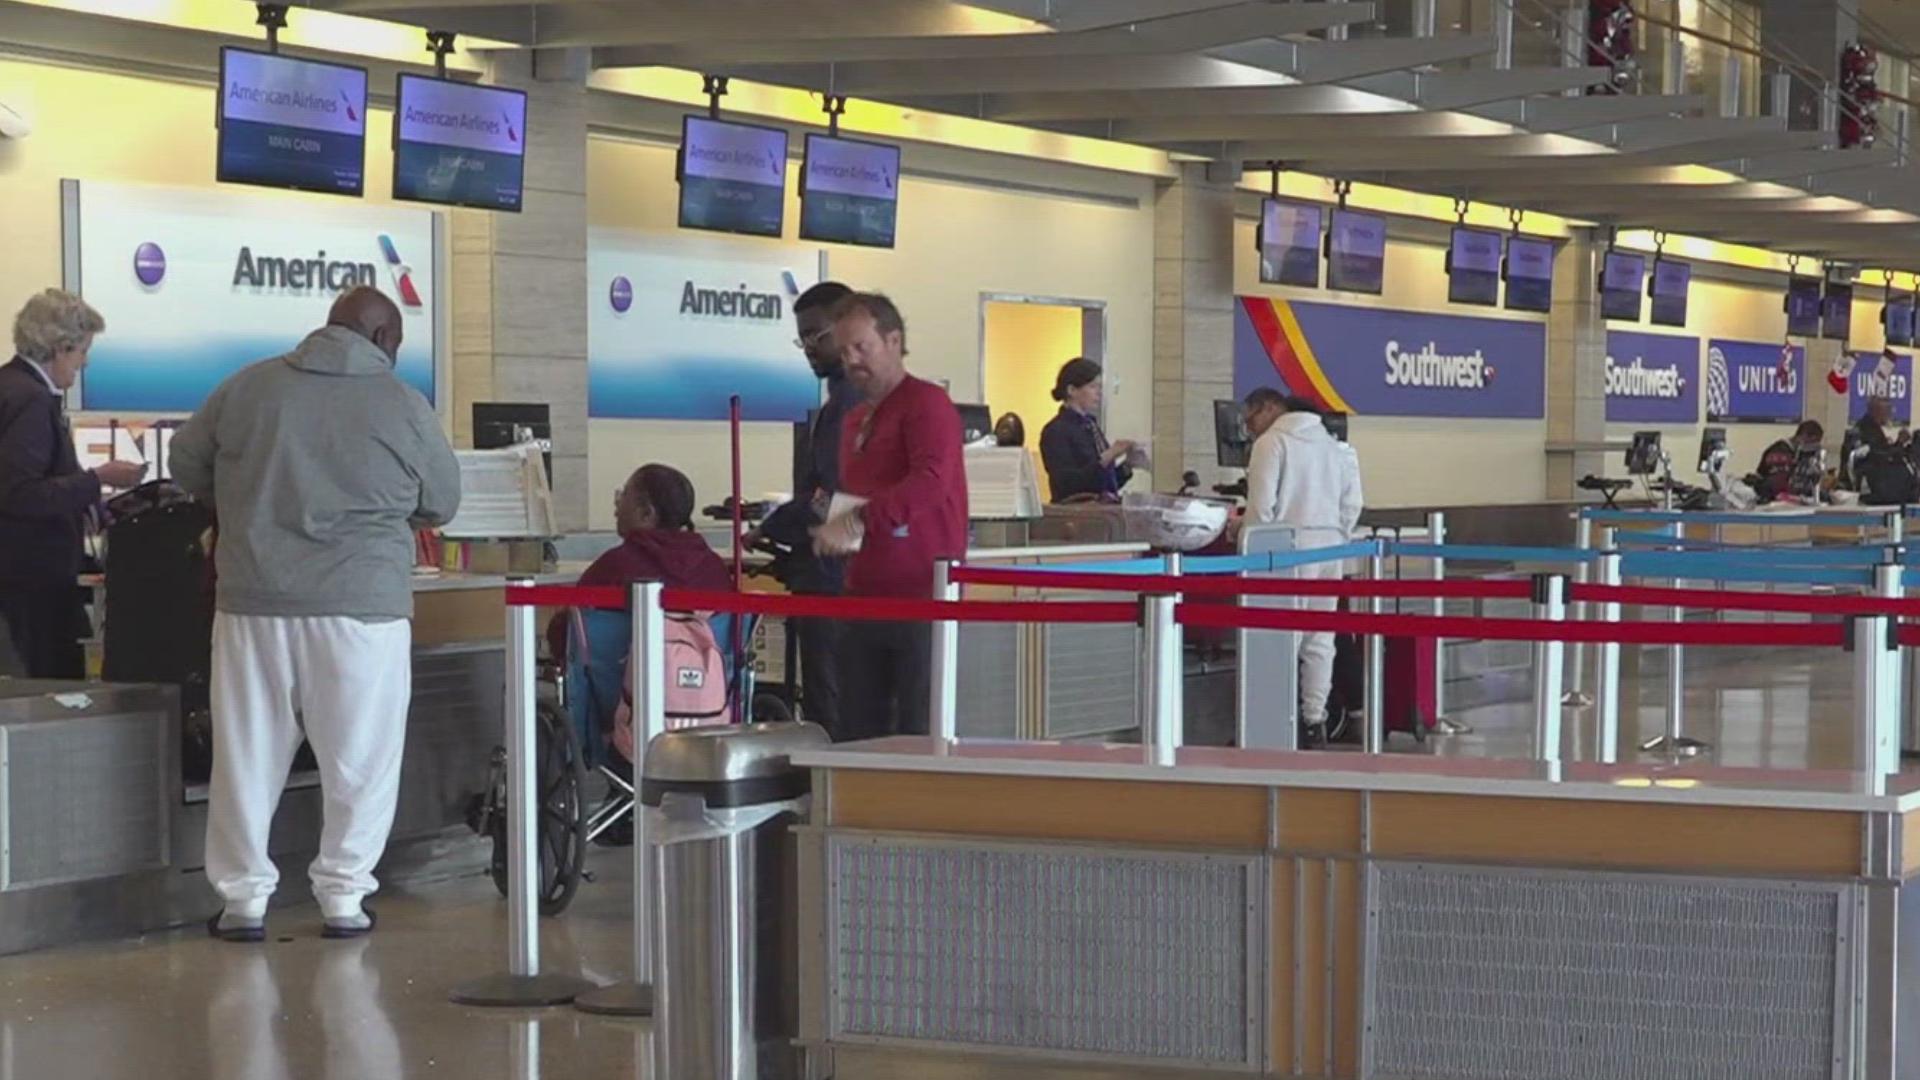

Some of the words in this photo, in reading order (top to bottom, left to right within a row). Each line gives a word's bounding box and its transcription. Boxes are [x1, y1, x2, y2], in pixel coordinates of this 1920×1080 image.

[229, 81, 291, 106] American
[292, 89, 338, 113] Airlines
[405, 106, 457, 128] American
[459, 113, 500, 135] Airlines
[268, 135, 292, 149] MAIN
[293, 139, 321, 153] CABIN
[233, 246, 376, 291] American
[680, 280, 782, 320] American
[1385, 340, 1484, 389] Southwest
[1604, 356, 1679, 398] Southwest
[1857, 372, 1906, 398] UNED
